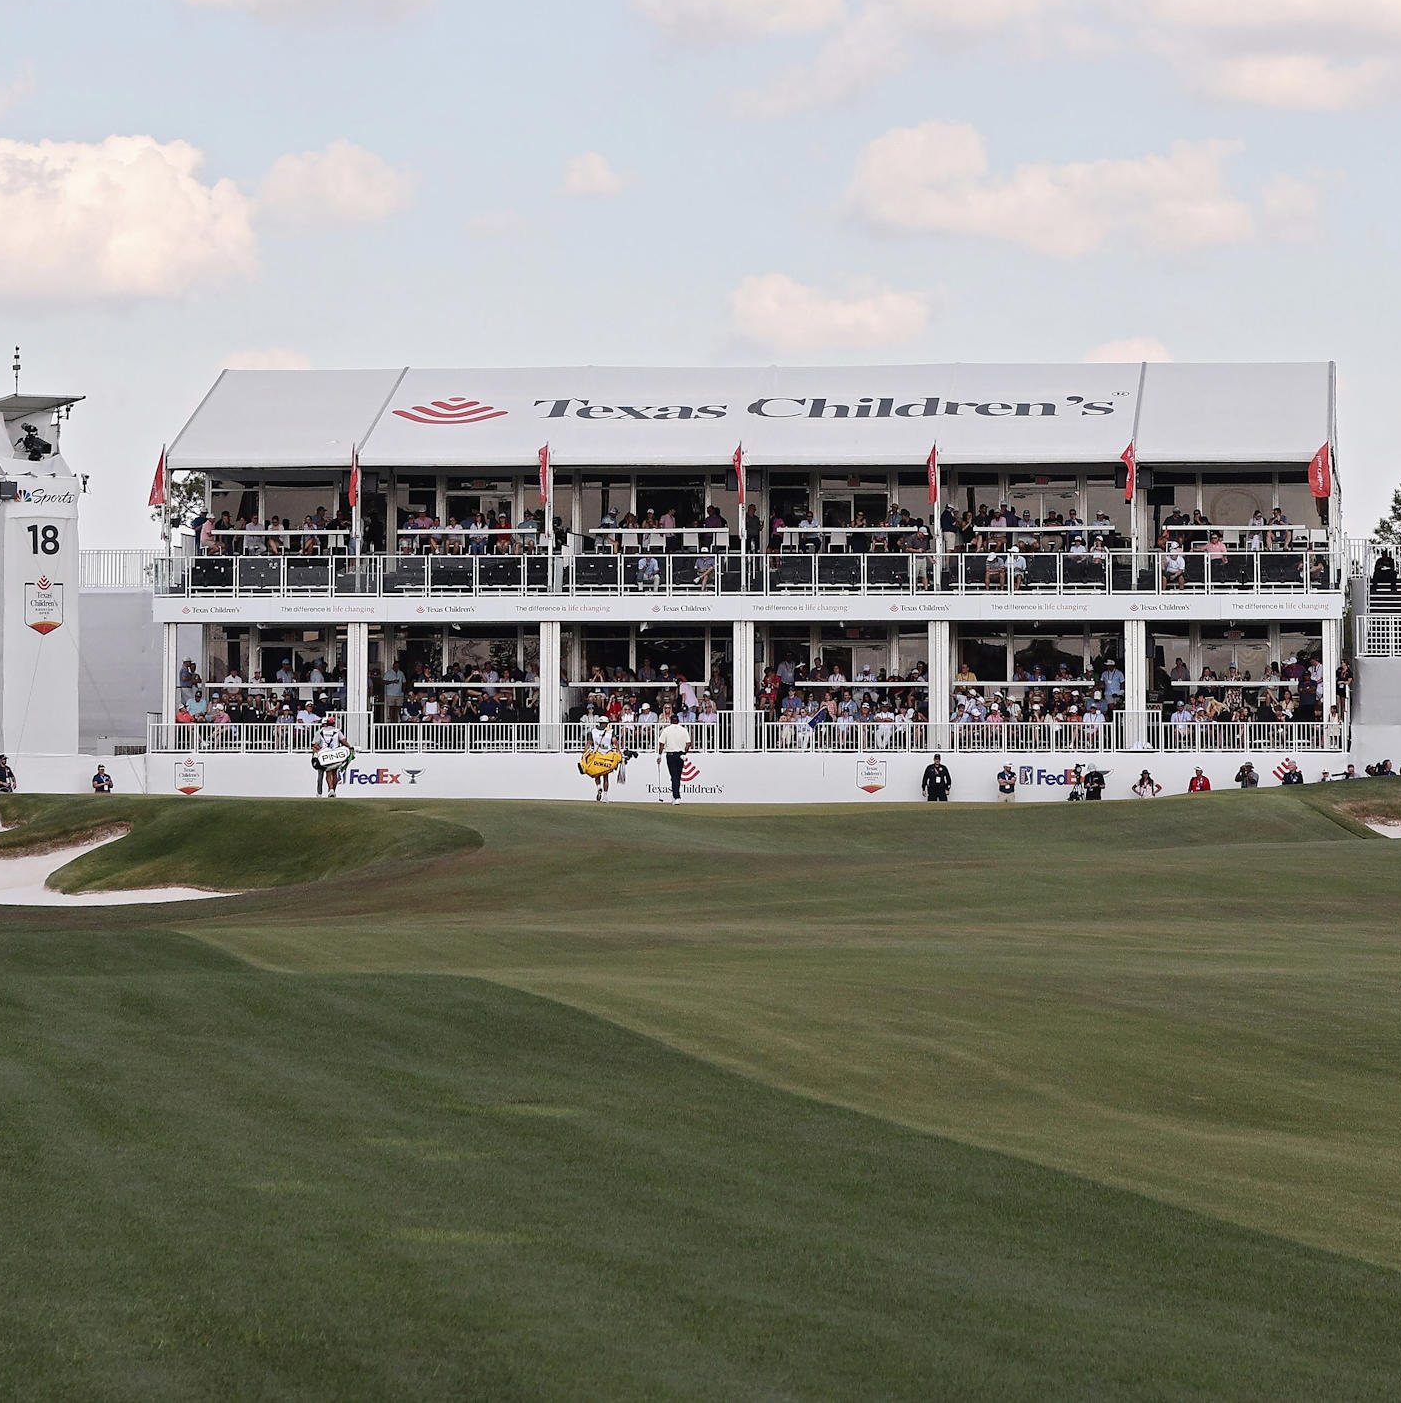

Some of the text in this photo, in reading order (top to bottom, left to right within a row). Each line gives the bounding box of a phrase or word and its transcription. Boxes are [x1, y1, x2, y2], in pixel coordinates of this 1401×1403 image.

[533, 395, 1114, 419] Texas Children's
[31, 489, 74, 505] Sports
[27, 524, 60, 555] 18
[344, 605, 375, 614] changing
[580, 604, 610, 613] changing
[817, 604, 848, 612] changing
[1056, 603, 1087, 612] changing
[1297, 603, 1329, 611] changing
[322, 751, 345, 762] PING
[350, 768, 402, 785] FedEx
[1036, 769, 1085, 785] FedE
[646, 784, 672, 794] Texas
